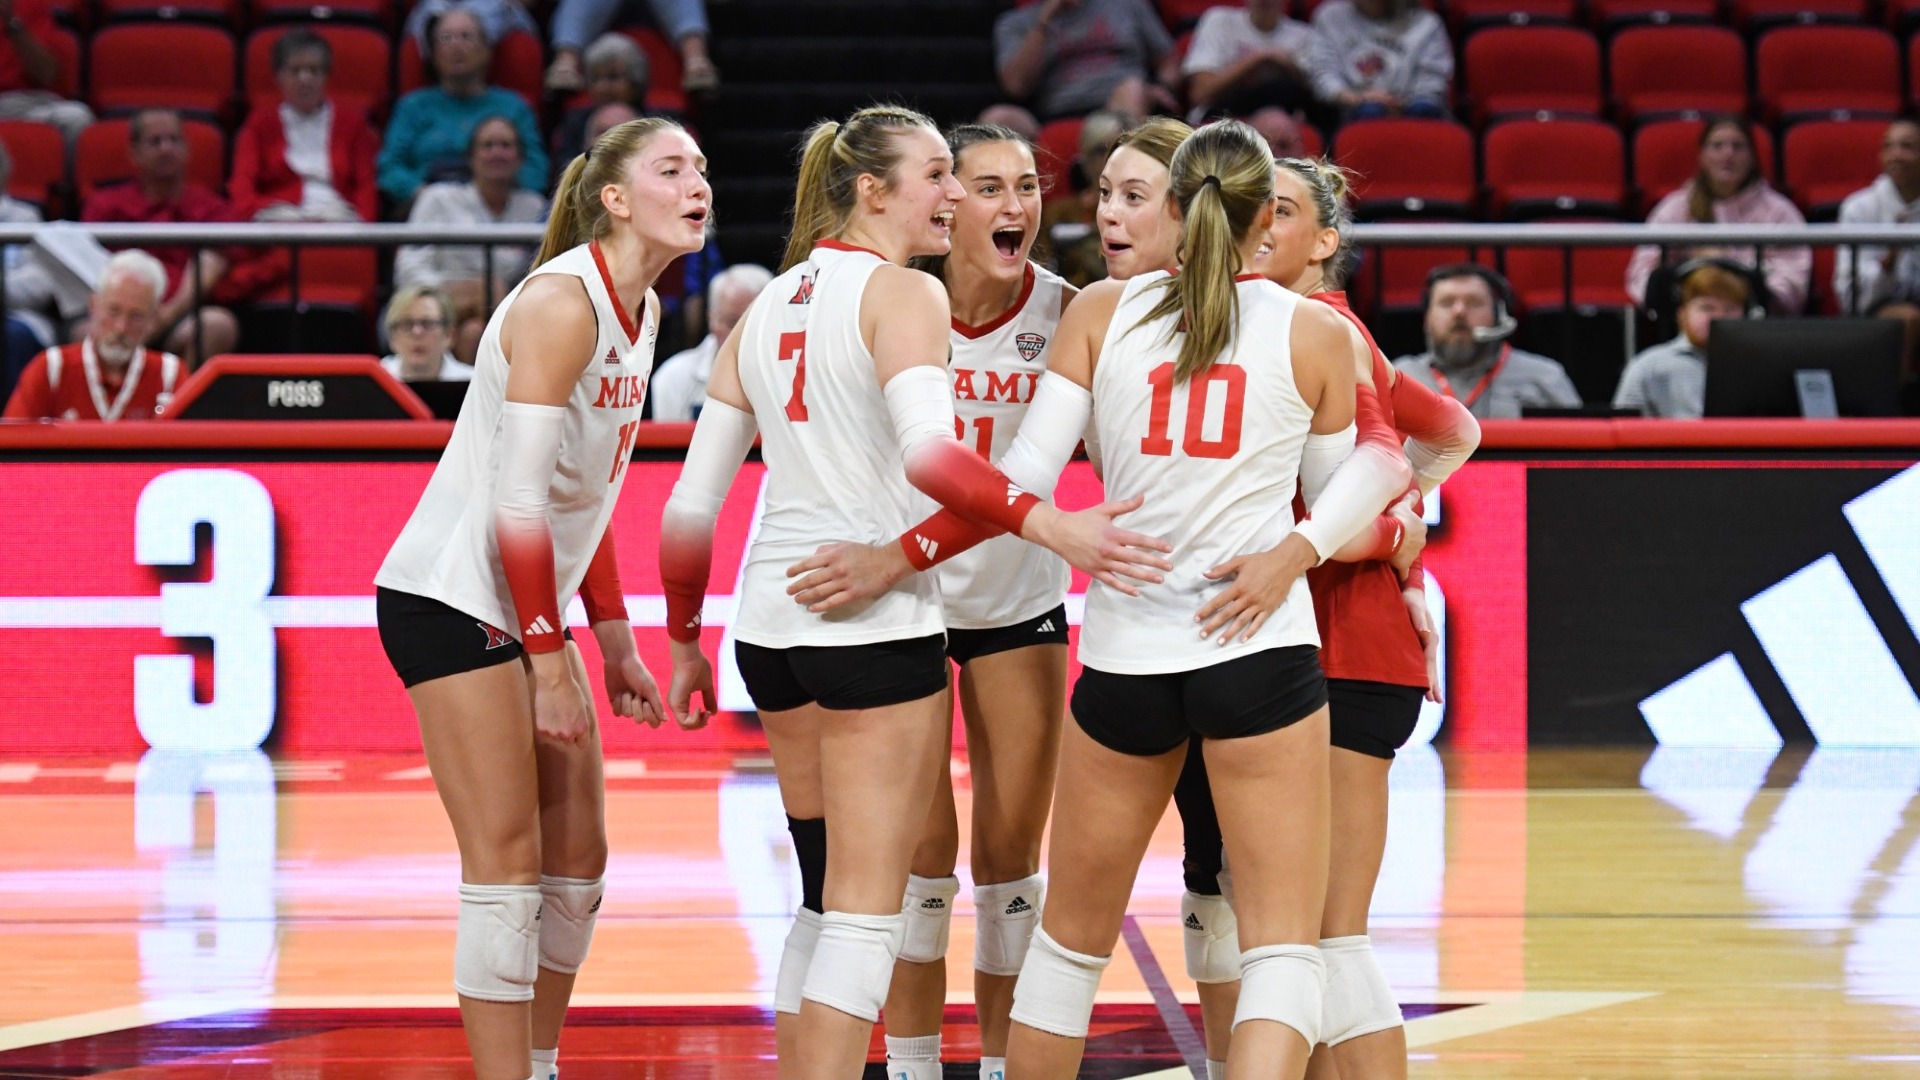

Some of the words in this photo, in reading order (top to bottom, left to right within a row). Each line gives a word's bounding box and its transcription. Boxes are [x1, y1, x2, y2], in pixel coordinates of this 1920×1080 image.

[592, 375, 646, 408] MIA
[778, 330, 809, 422] 7
[954, 368, 1040, 404] AMI
[1141, 361, 1247, 459] 10
[134, 468, 276, 749] 3
[1005, 904, 1031, 915] adidas
